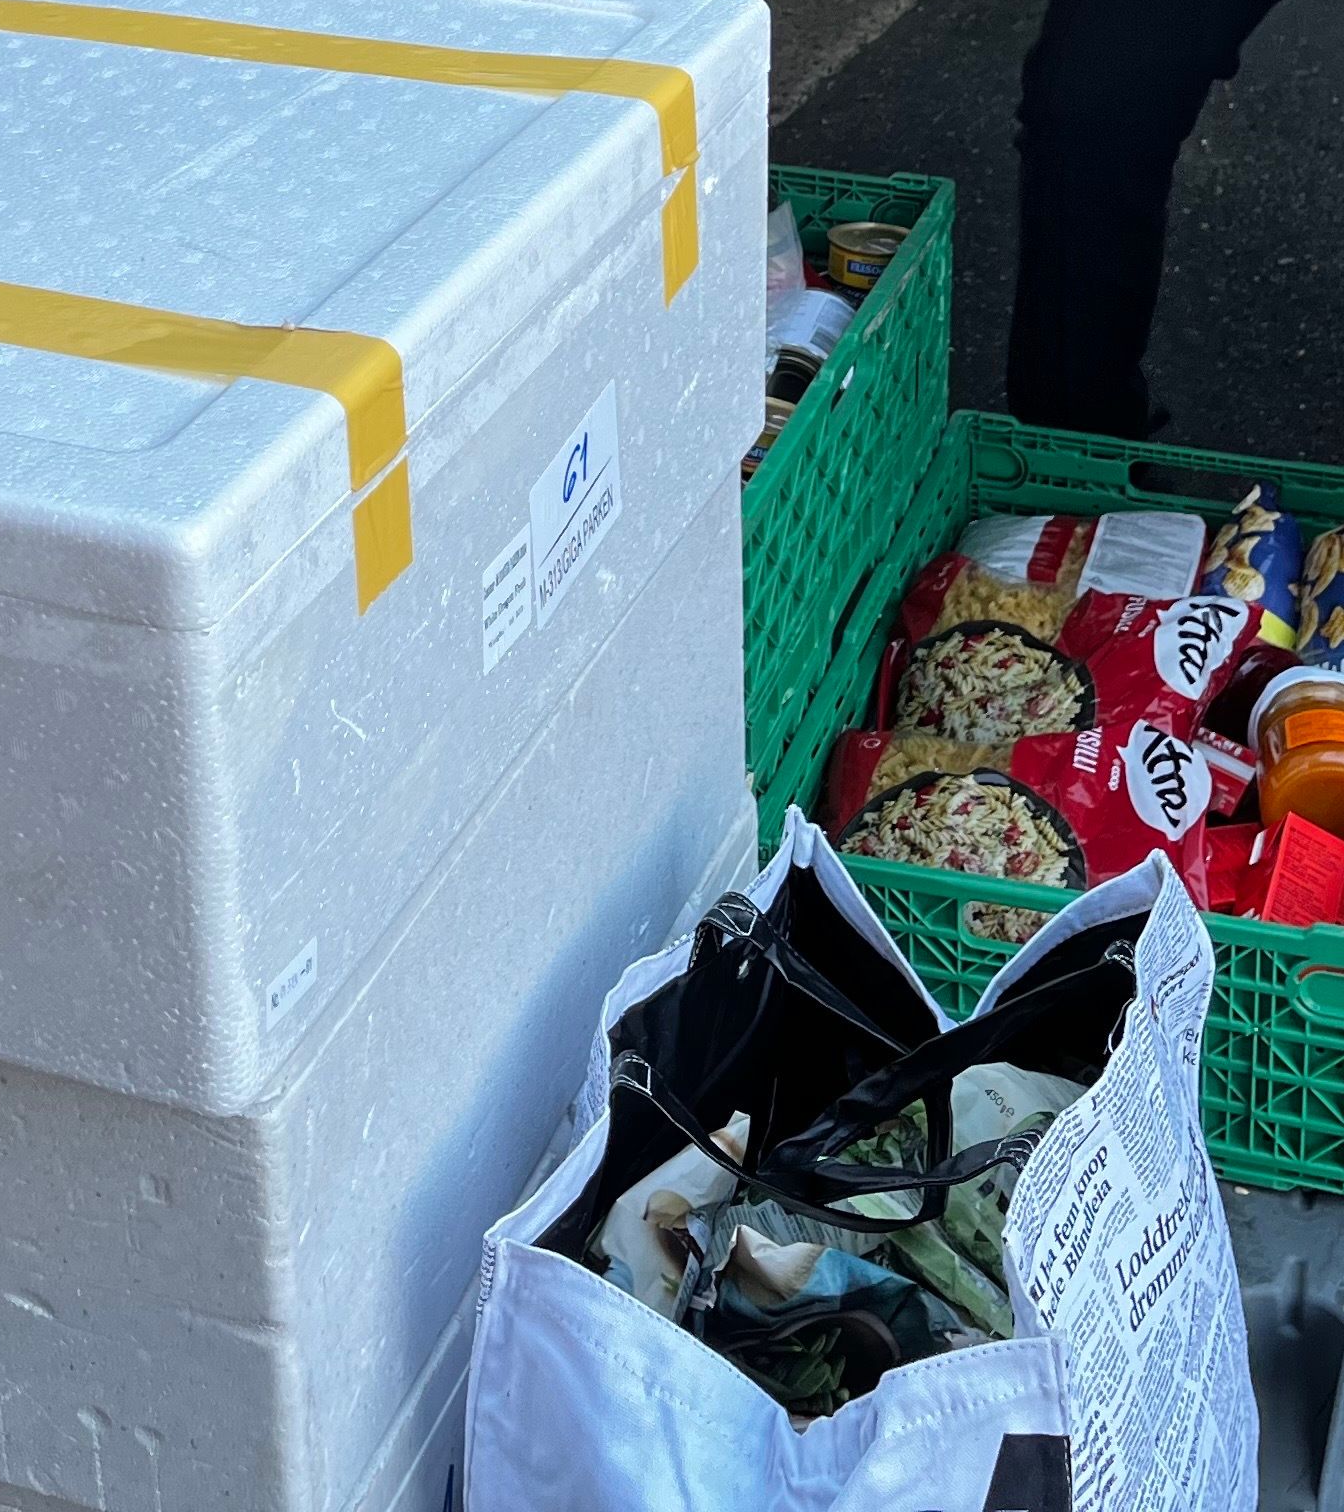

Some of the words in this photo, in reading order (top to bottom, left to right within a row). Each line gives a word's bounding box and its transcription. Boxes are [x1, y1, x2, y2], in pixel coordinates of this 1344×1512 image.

[562, 431, 589, 504] 61
[583, 483, 614, 547] PARKEN
[1053, 1201, 1080, 1250] fem
[1073, 1145, 1109, 1204] knop
[1062, 1178, 1112, 1279] Blindleia
